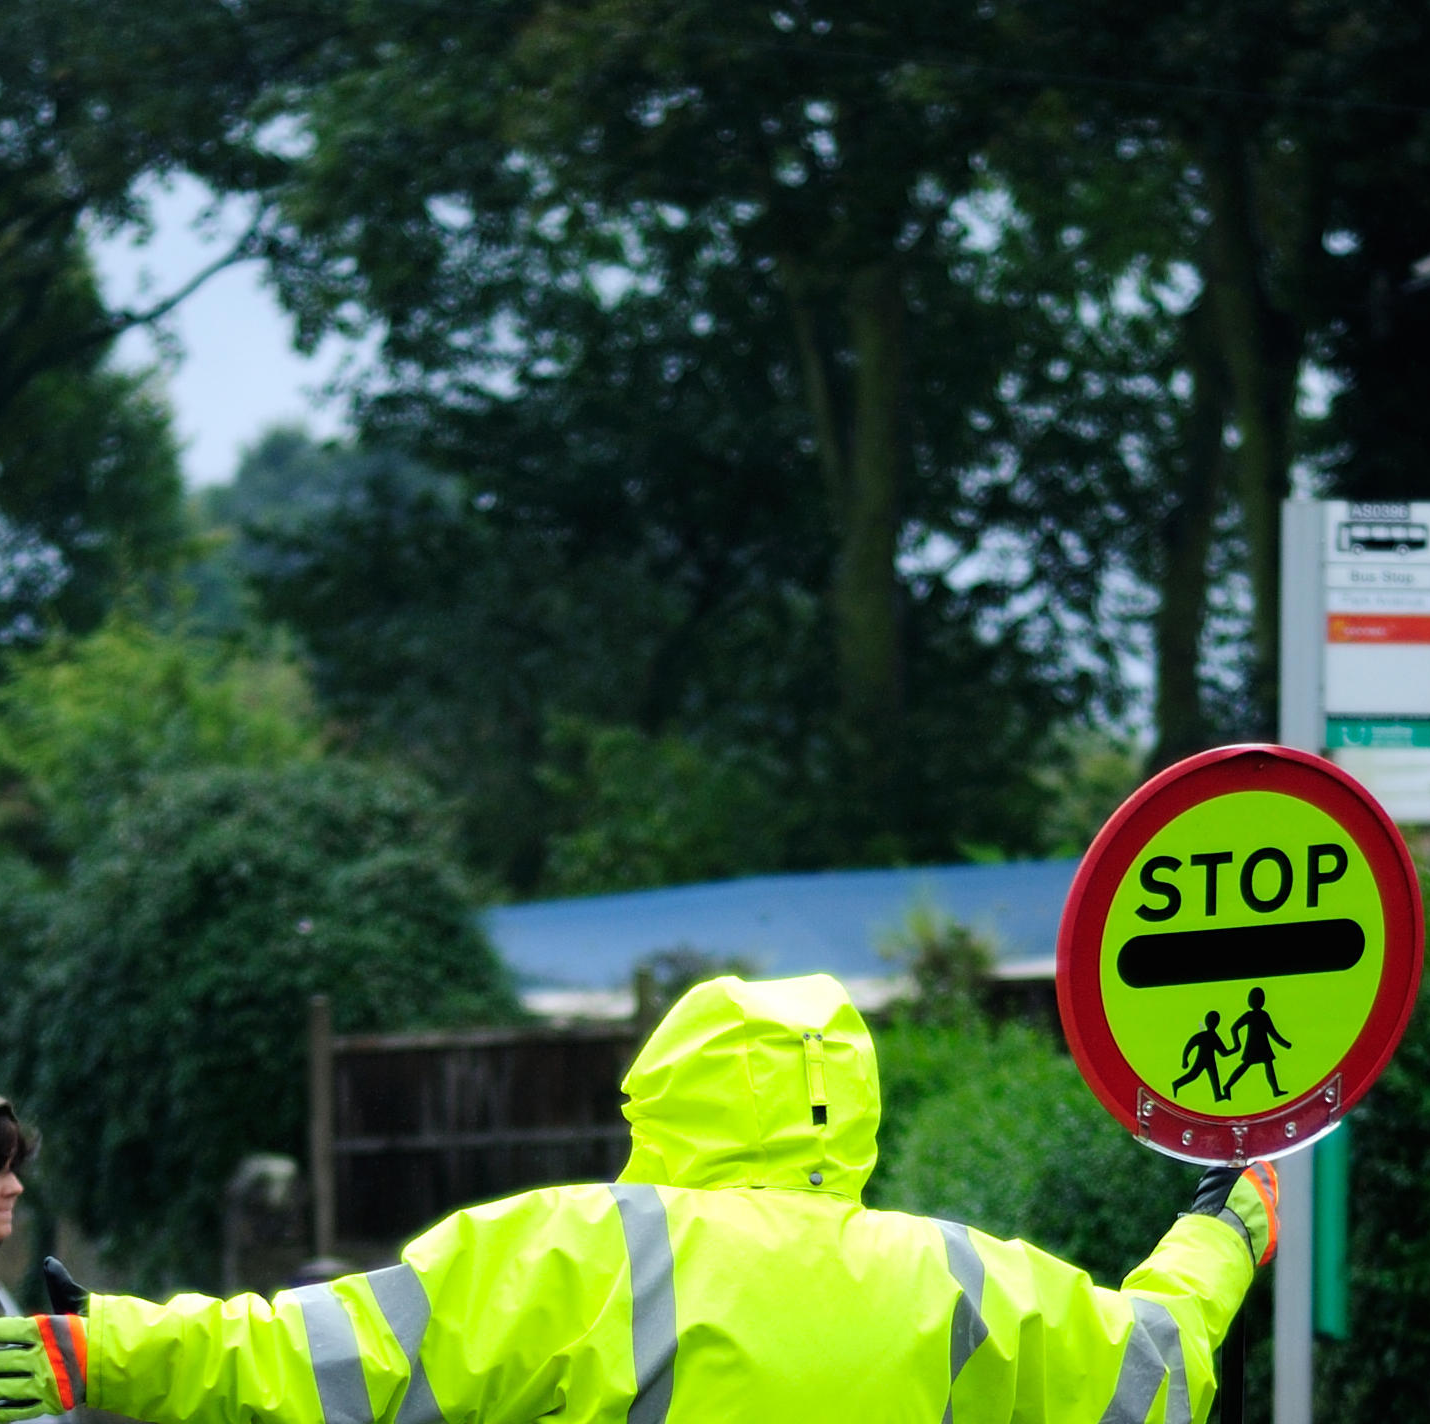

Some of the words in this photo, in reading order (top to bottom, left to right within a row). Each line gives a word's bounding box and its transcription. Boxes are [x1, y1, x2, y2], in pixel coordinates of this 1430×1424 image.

[1350, 570, 1376, 582] Bus
[1382, 570, 1415, 585] Stop
[1135, 843, 1348, 922] STOP
